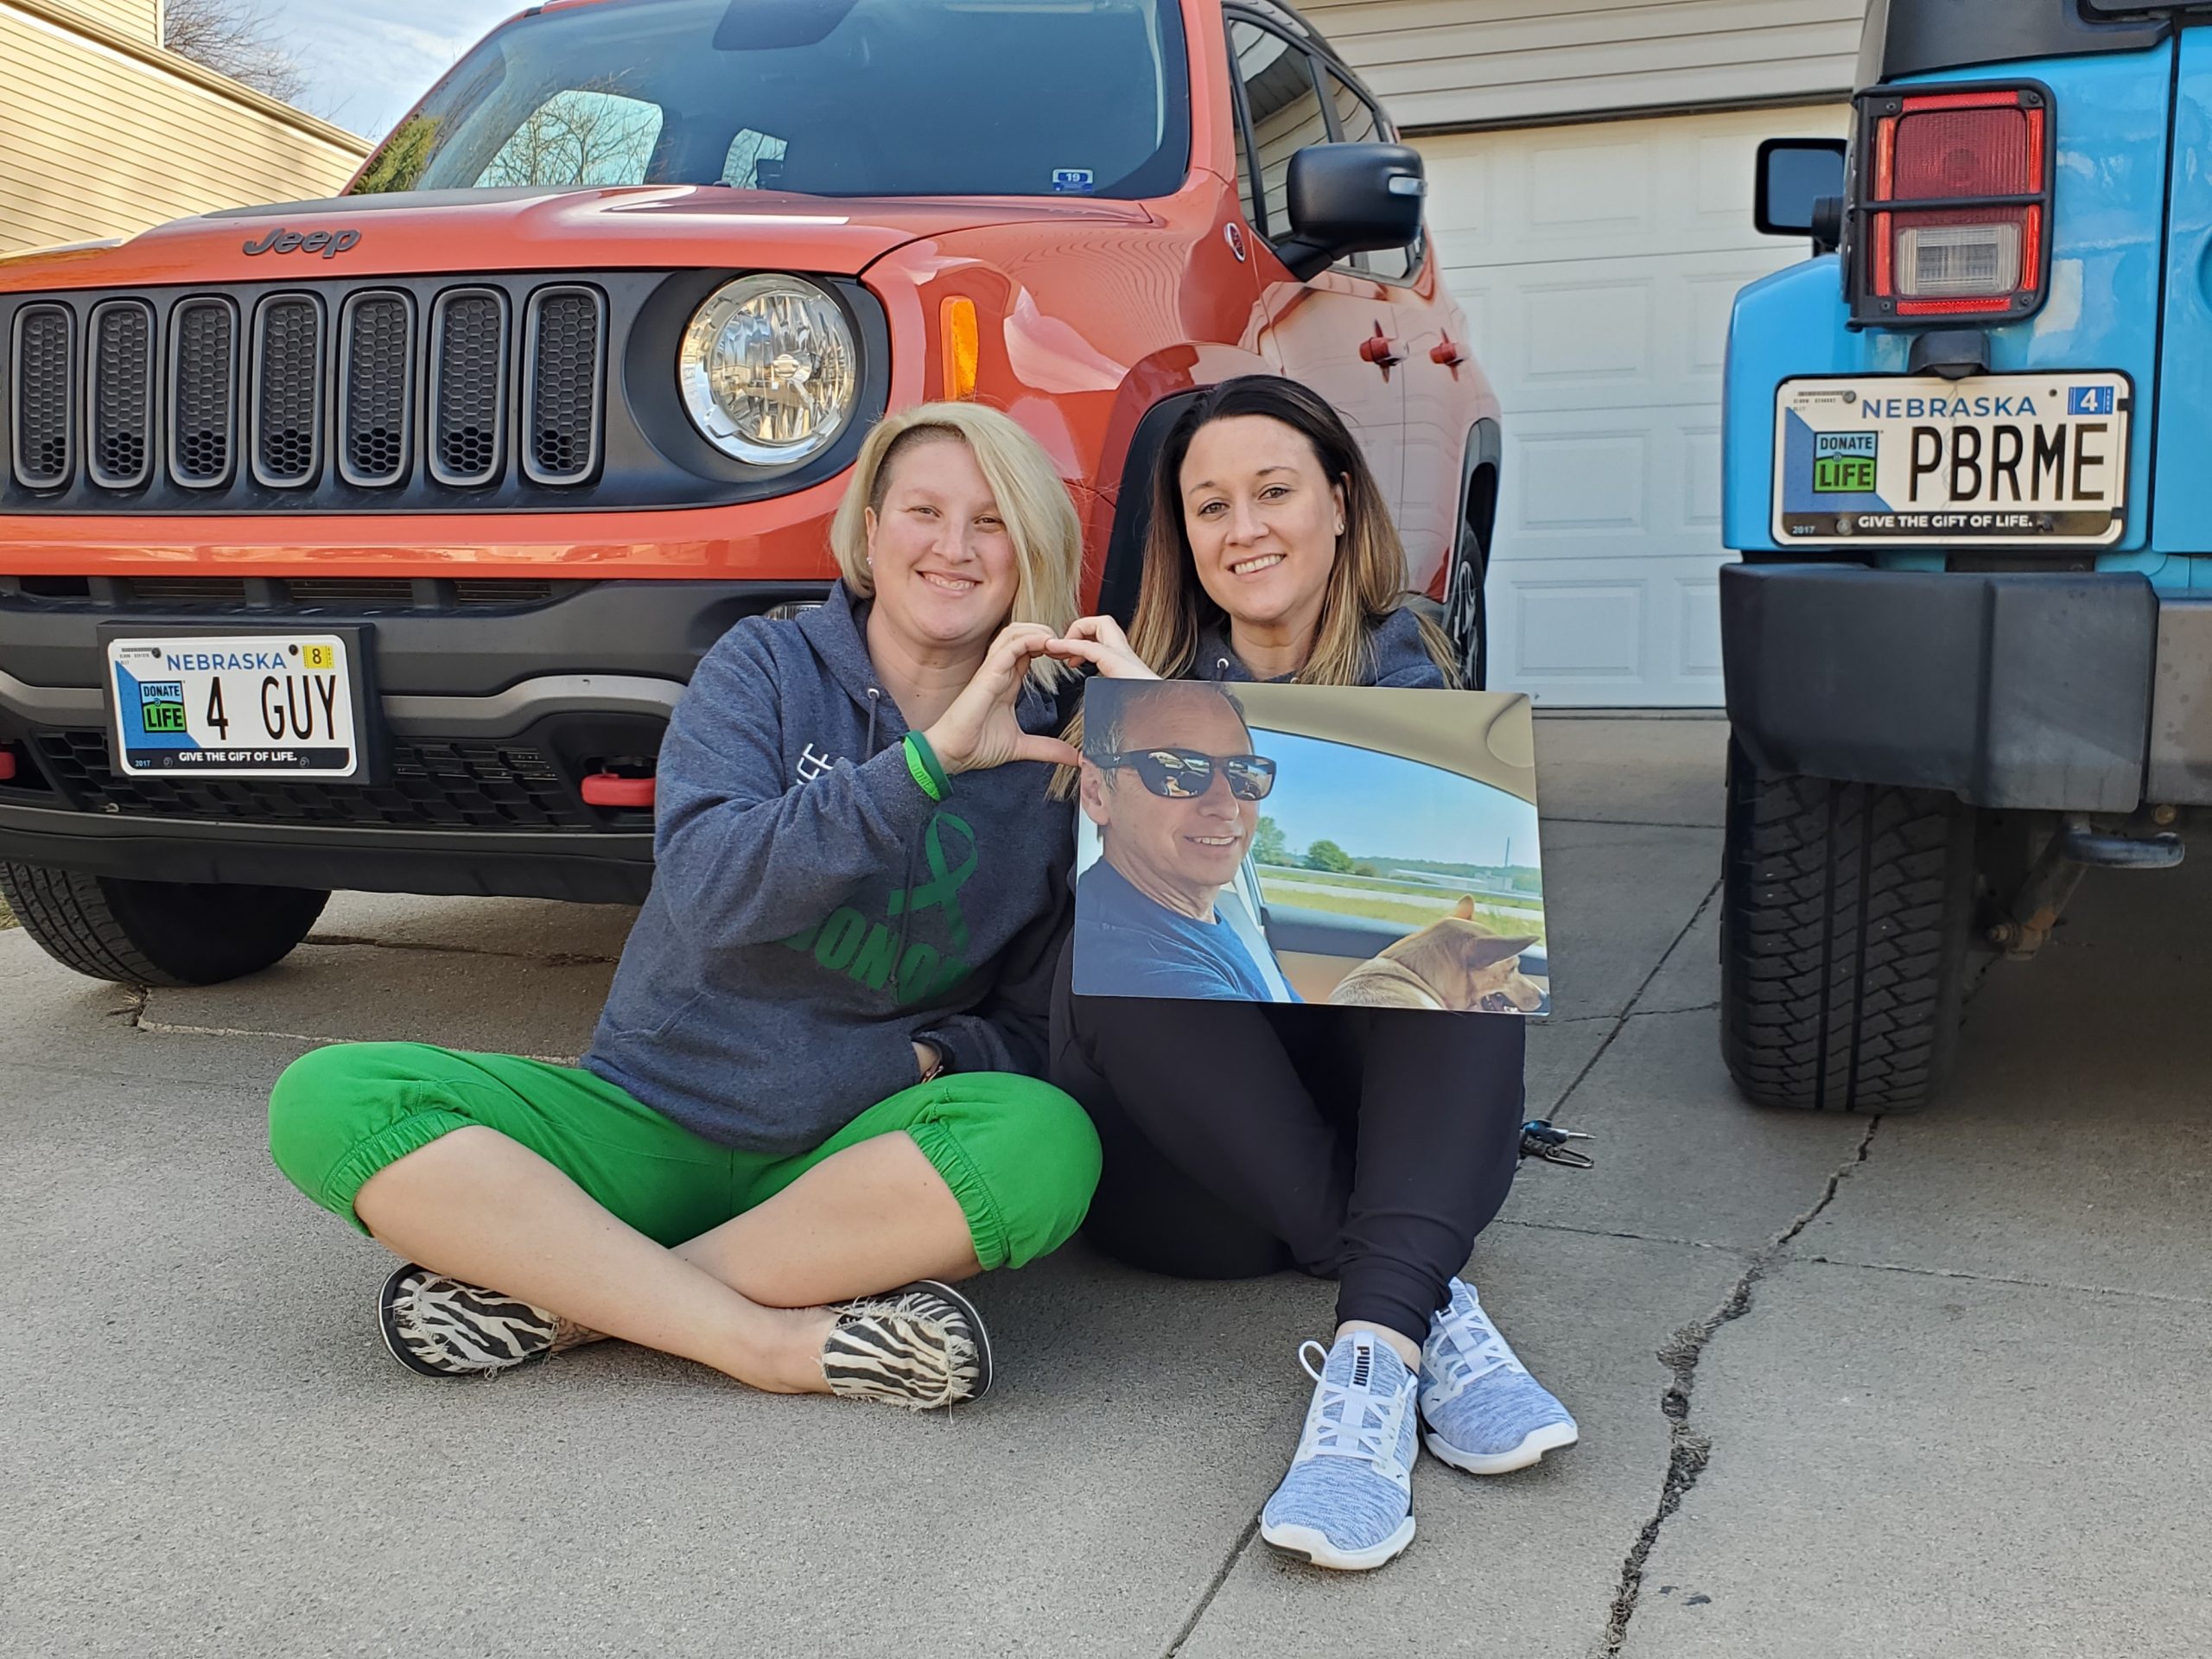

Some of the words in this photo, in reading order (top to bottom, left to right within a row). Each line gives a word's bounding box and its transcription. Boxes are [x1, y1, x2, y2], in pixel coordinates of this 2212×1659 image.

[1065, 173, 1081, 181] 19
[243, 228, 362, 259] Jeep
[1860, 396, 2037, 419] NEBRASKA
[2080, 388, 2098, 411] 4
[1820, 436, 1873, 450] DONATE
[1909, 423, 2109, 503] PBRME
[1819, 463, 1872, 487] LIFE
[1792, 525, 1815, 535] 2017
[1858, 516, 1895, 528] GIVE
[1897, 516, 1929, 527] THE
[1931, 516, 1967, 527] GIFT
[1969, 516, 1992, 527] OF
[1995, 515, 2033, 527] LIFE.
[167, 652, 287, 671] NEBRASKA
[312, 648, 322, 664] 8
[143, 684, 181, 697] DONATE
[146, 708, 184, 728] LIFE
[207, 676, 229, 741] 4
[261, 675, 336, 741] GUY
[179, 752, 204, 762] GIVE
[205, 752, 226, 761] THE
[227, 752, 252, 761] GIFT
[254, 752, 270, 761] OF
[271, 752, 298, 761] LIFE.
[779, 906, 973, 1006] ONO
[1353, 1346, 1370, 1387] PUMA
